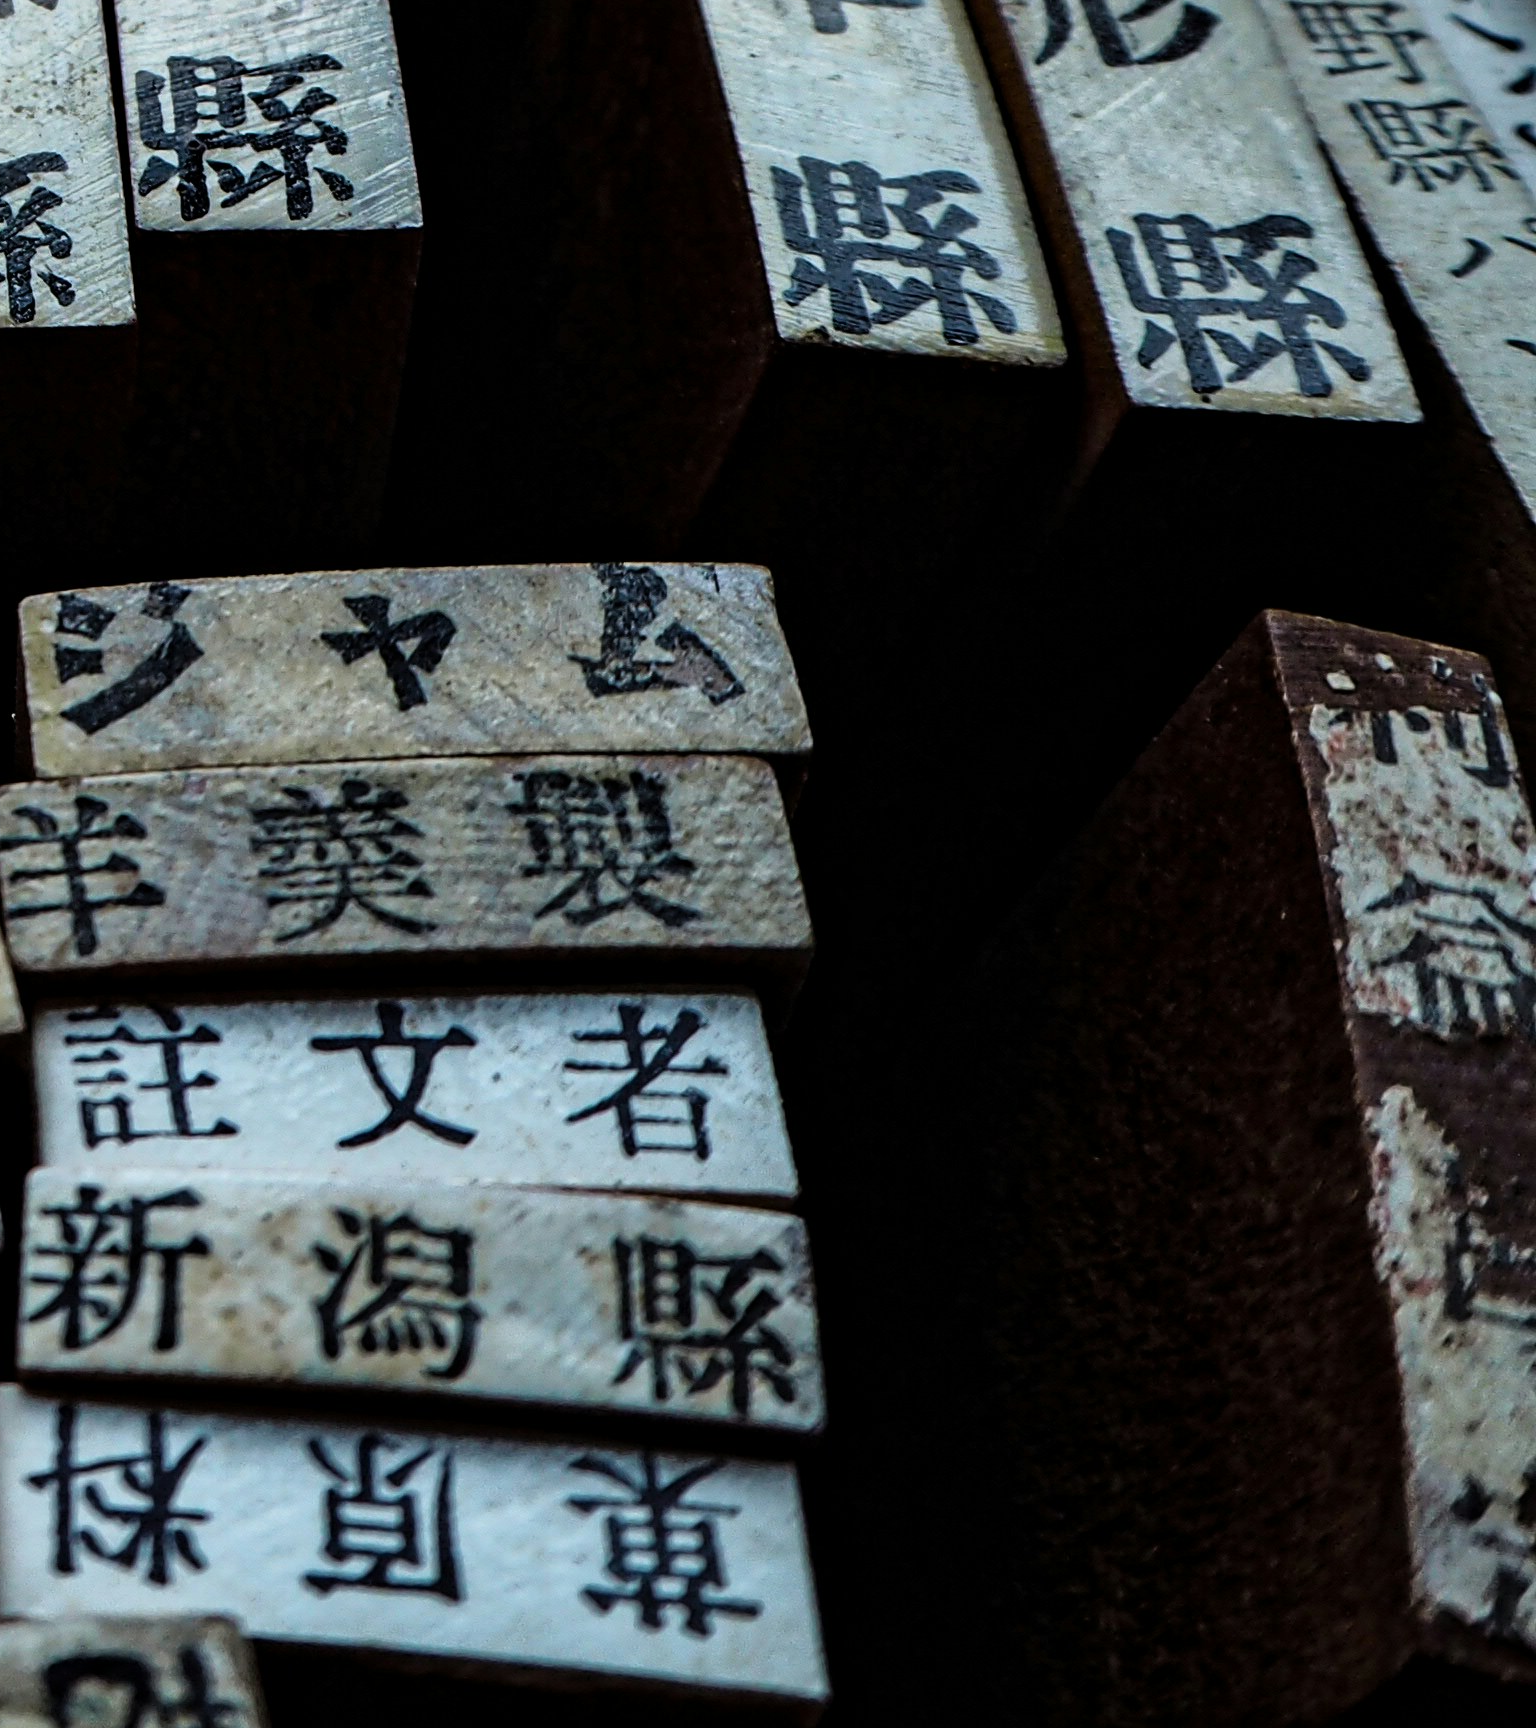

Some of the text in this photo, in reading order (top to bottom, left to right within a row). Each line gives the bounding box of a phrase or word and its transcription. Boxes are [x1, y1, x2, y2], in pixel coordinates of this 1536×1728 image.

[53, 562, 745, 735] ジャム
[64, 999, 728, 1163] 註文者
[28, 1185, 799, 1417] 新潟縣
